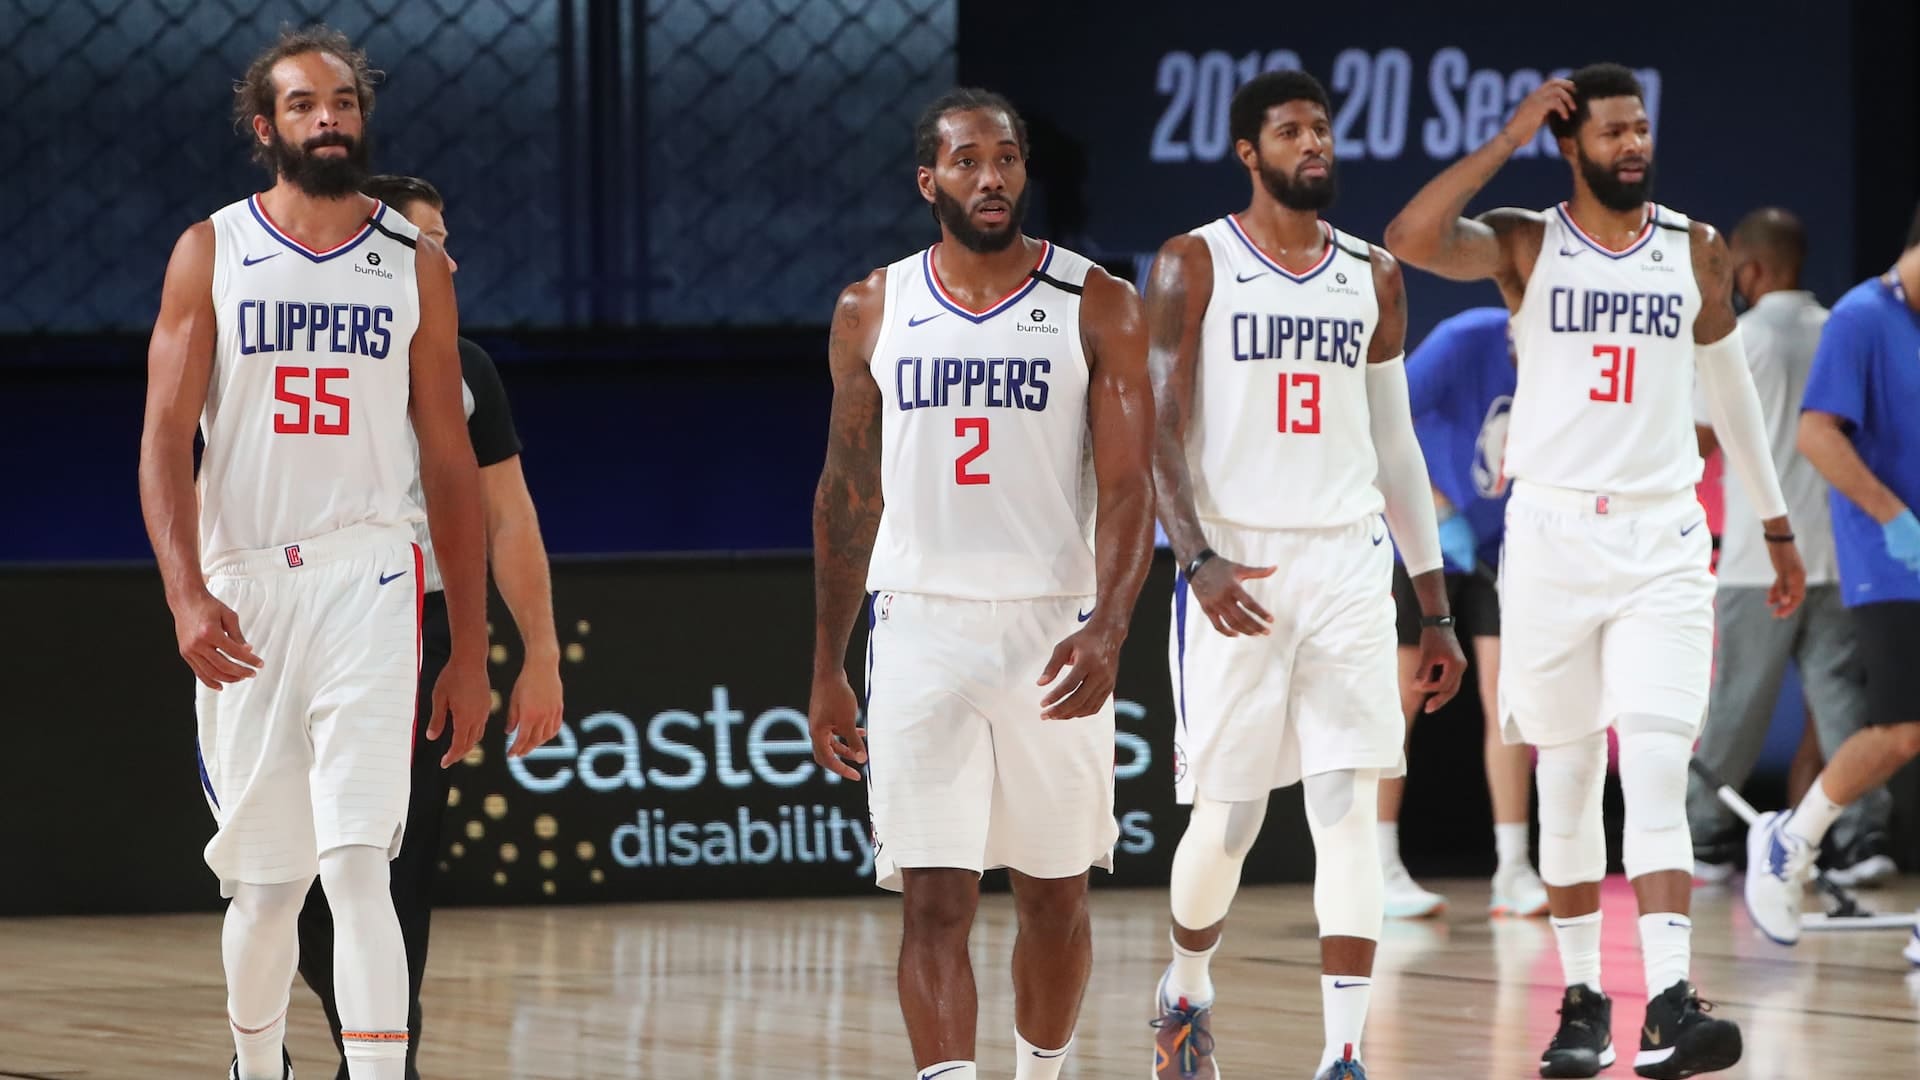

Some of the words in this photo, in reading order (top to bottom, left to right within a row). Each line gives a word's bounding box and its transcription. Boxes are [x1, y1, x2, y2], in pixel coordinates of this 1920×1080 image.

[354, 264, 393, 279] bumble
[238, 300, 393, 360] CLIPPERS
[1016, 323, 1059, 334] bumble
[1231, 312, 1364, 369] CLIPPERS
[1551, 287, 1683, 339] CLIPPERS
[274, 366, 349, 435] 55
[895, 357, 1051, 412] CLIPPERS
[1589, 345, 1636, 403] 31
[1277, 373, 1321, 434] 13
[954, 417, 990, 485] 2
[610, 804, 875, 877] disability
